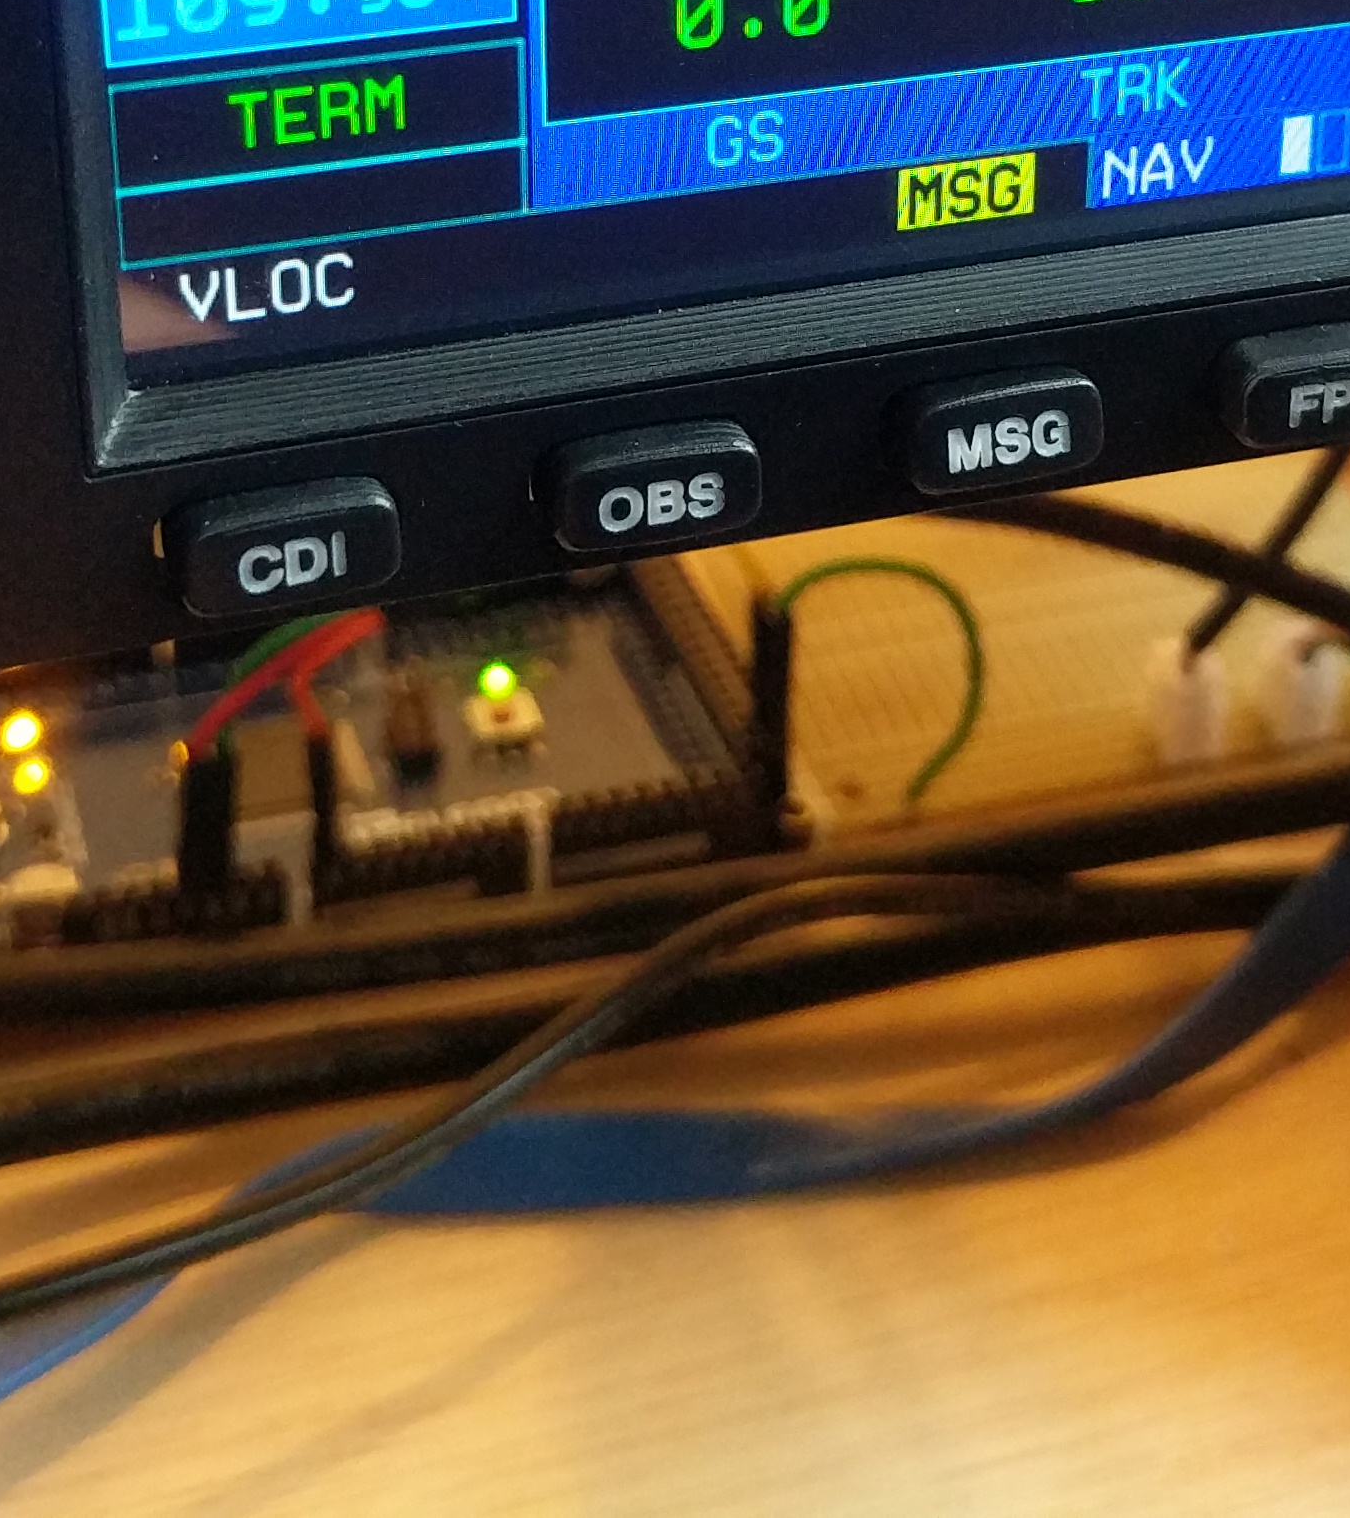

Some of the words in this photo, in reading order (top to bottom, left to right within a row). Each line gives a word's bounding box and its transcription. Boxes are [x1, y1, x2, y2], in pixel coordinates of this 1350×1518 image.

[227, 74, 409, 149] TERM
[1079, 59, 1190, 122] TRK
[704, 111, 786, 169] GS
[1100, 135, 1218, 200] NAV
[905, 162, 1025, 222] MSG
[177, 252, 355, 325] VLOC
[945, 408, 1074, 475] MSG
[595, 470, 726, 536] OBS
[236, 528, 352, 595] CDI
